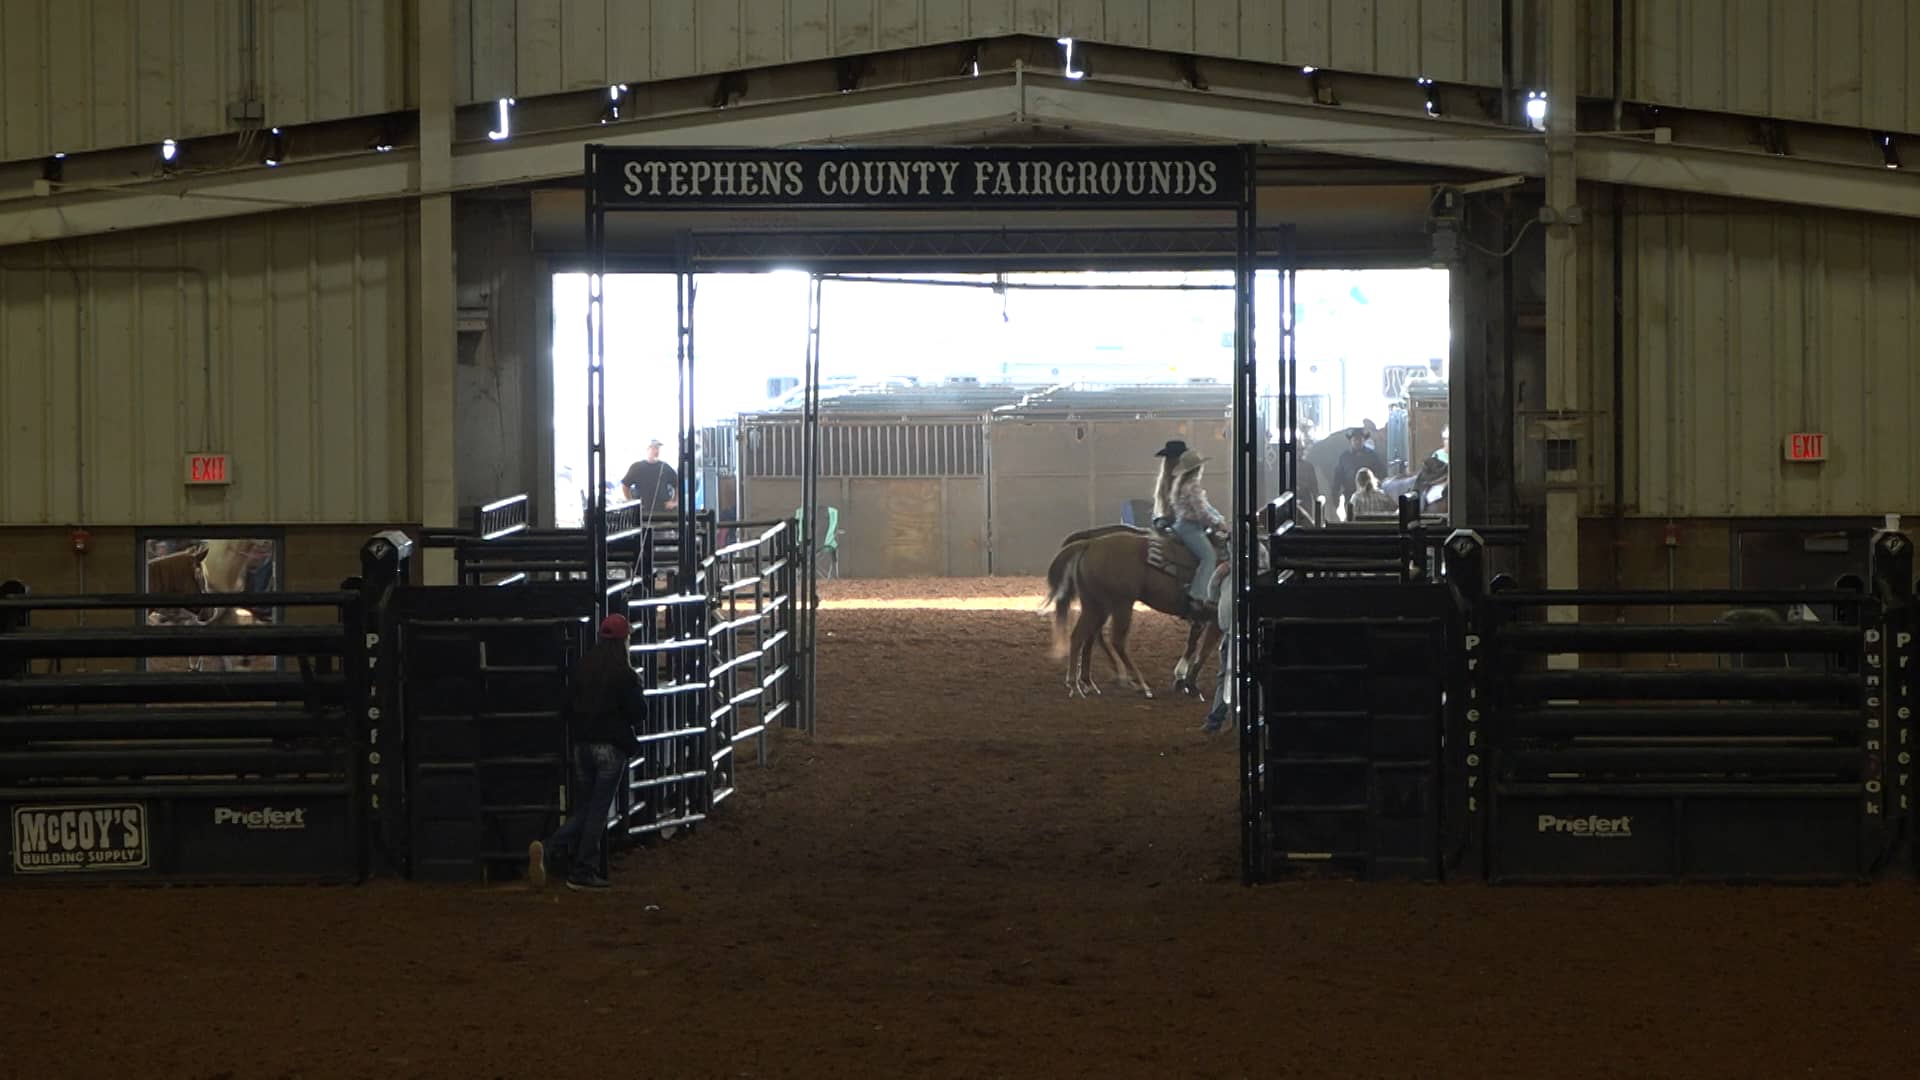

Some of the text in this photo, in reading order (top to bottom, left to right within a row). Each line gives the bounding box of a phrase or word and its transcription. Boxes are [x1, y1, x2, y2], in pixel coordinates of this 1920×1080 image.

[623, 160, 1217, 196] STEPHENS COUNTY FAIRGROUNDS
[1791, 434, 1824, 459] EXIT
[192, 456, 225, 481] EXIT
[1864, 628, 1881, 751] Duncan
[365, 632, 381, 809] Priefert
[1464, 634, 1481, 812] Priefert
[1896, 631, 1912, 809] Priefert
[214, 806, 305, 825] Priefert
[1537, 815, 1632, 833] Priefert
[22, 849, 136, 865] BUILDING SUPPLY
